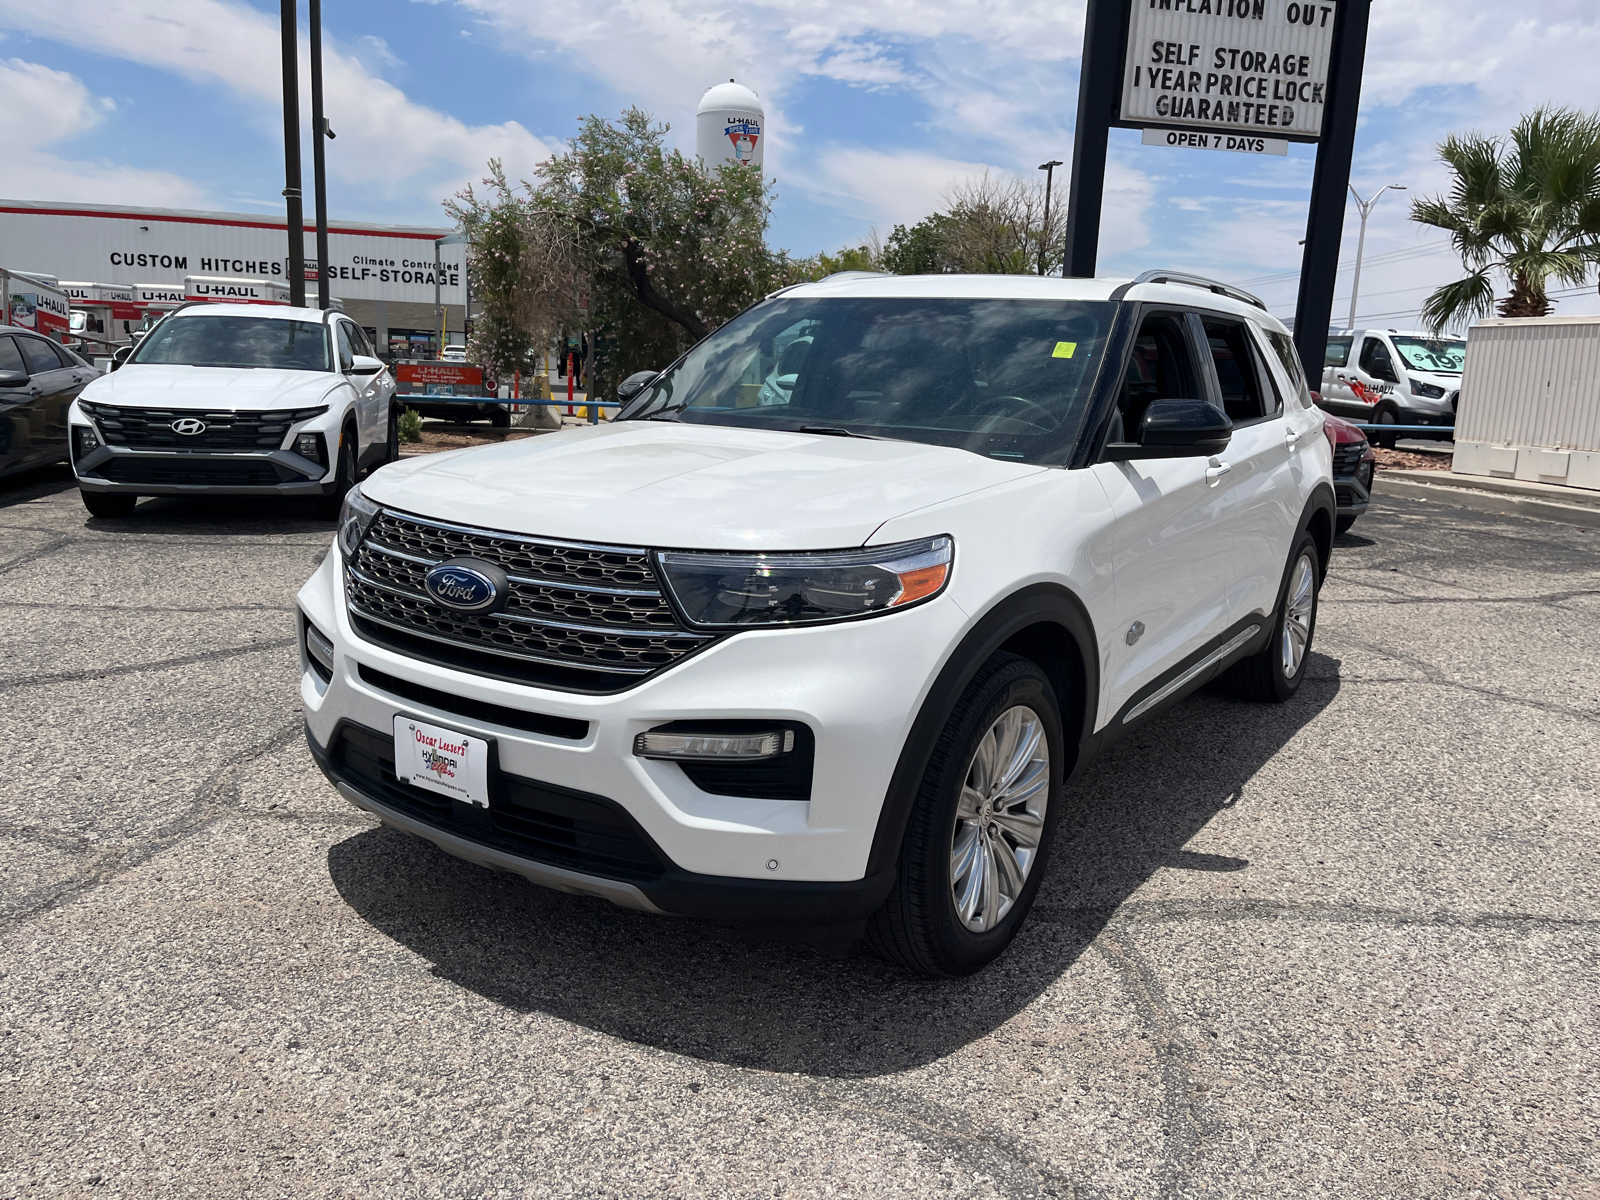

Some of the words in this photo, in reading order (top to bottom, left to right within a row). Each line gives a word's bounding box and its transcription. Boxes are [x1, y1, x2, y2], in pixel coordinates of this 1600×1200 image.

[1286, 3, 1332, 28] OUT
[1151, 41, 1201, 66] SELF
[1214, 47, 1310, 77] STORAGE
[1148, 66, 1202, 93] YEAR
[1205, 73, 1268, 99] PRICE
[1273, 79, 1325, 104] LOCK
[1155, 95, 1295, 127] GUARANTEED
[728, 118, 758, 126] U-HAUL
[1166, 132, 1208, 148] OPEN
[1214, 136, 1222, 149] 7
[1226, 136, 1265, 152] DAYS
[110, 252, 188, 270] CUSTOM
[201, 258, 282, 275] HITCHES
[352, 255, 395, 267] Climate
[328, 265, 459, 287] SELF-STORAGE
[110, 291, 132, 301] U-HAUL
[142, 291, 185, 301] U-HAU
[195, 284, 259, 298] U-HAUL
[36, 293, 67, 316] U-HAUL
[417, 366, 462, 376] U-HAUL
[1363, 383, 1395, 395] U-HAUL
[437, 573, 477, 601] Ford
[415, 729, 437, 748] Oscar
[438, 737, 465, 757] Leeser's
[422, 749, 458, 769] HYUNDAI
